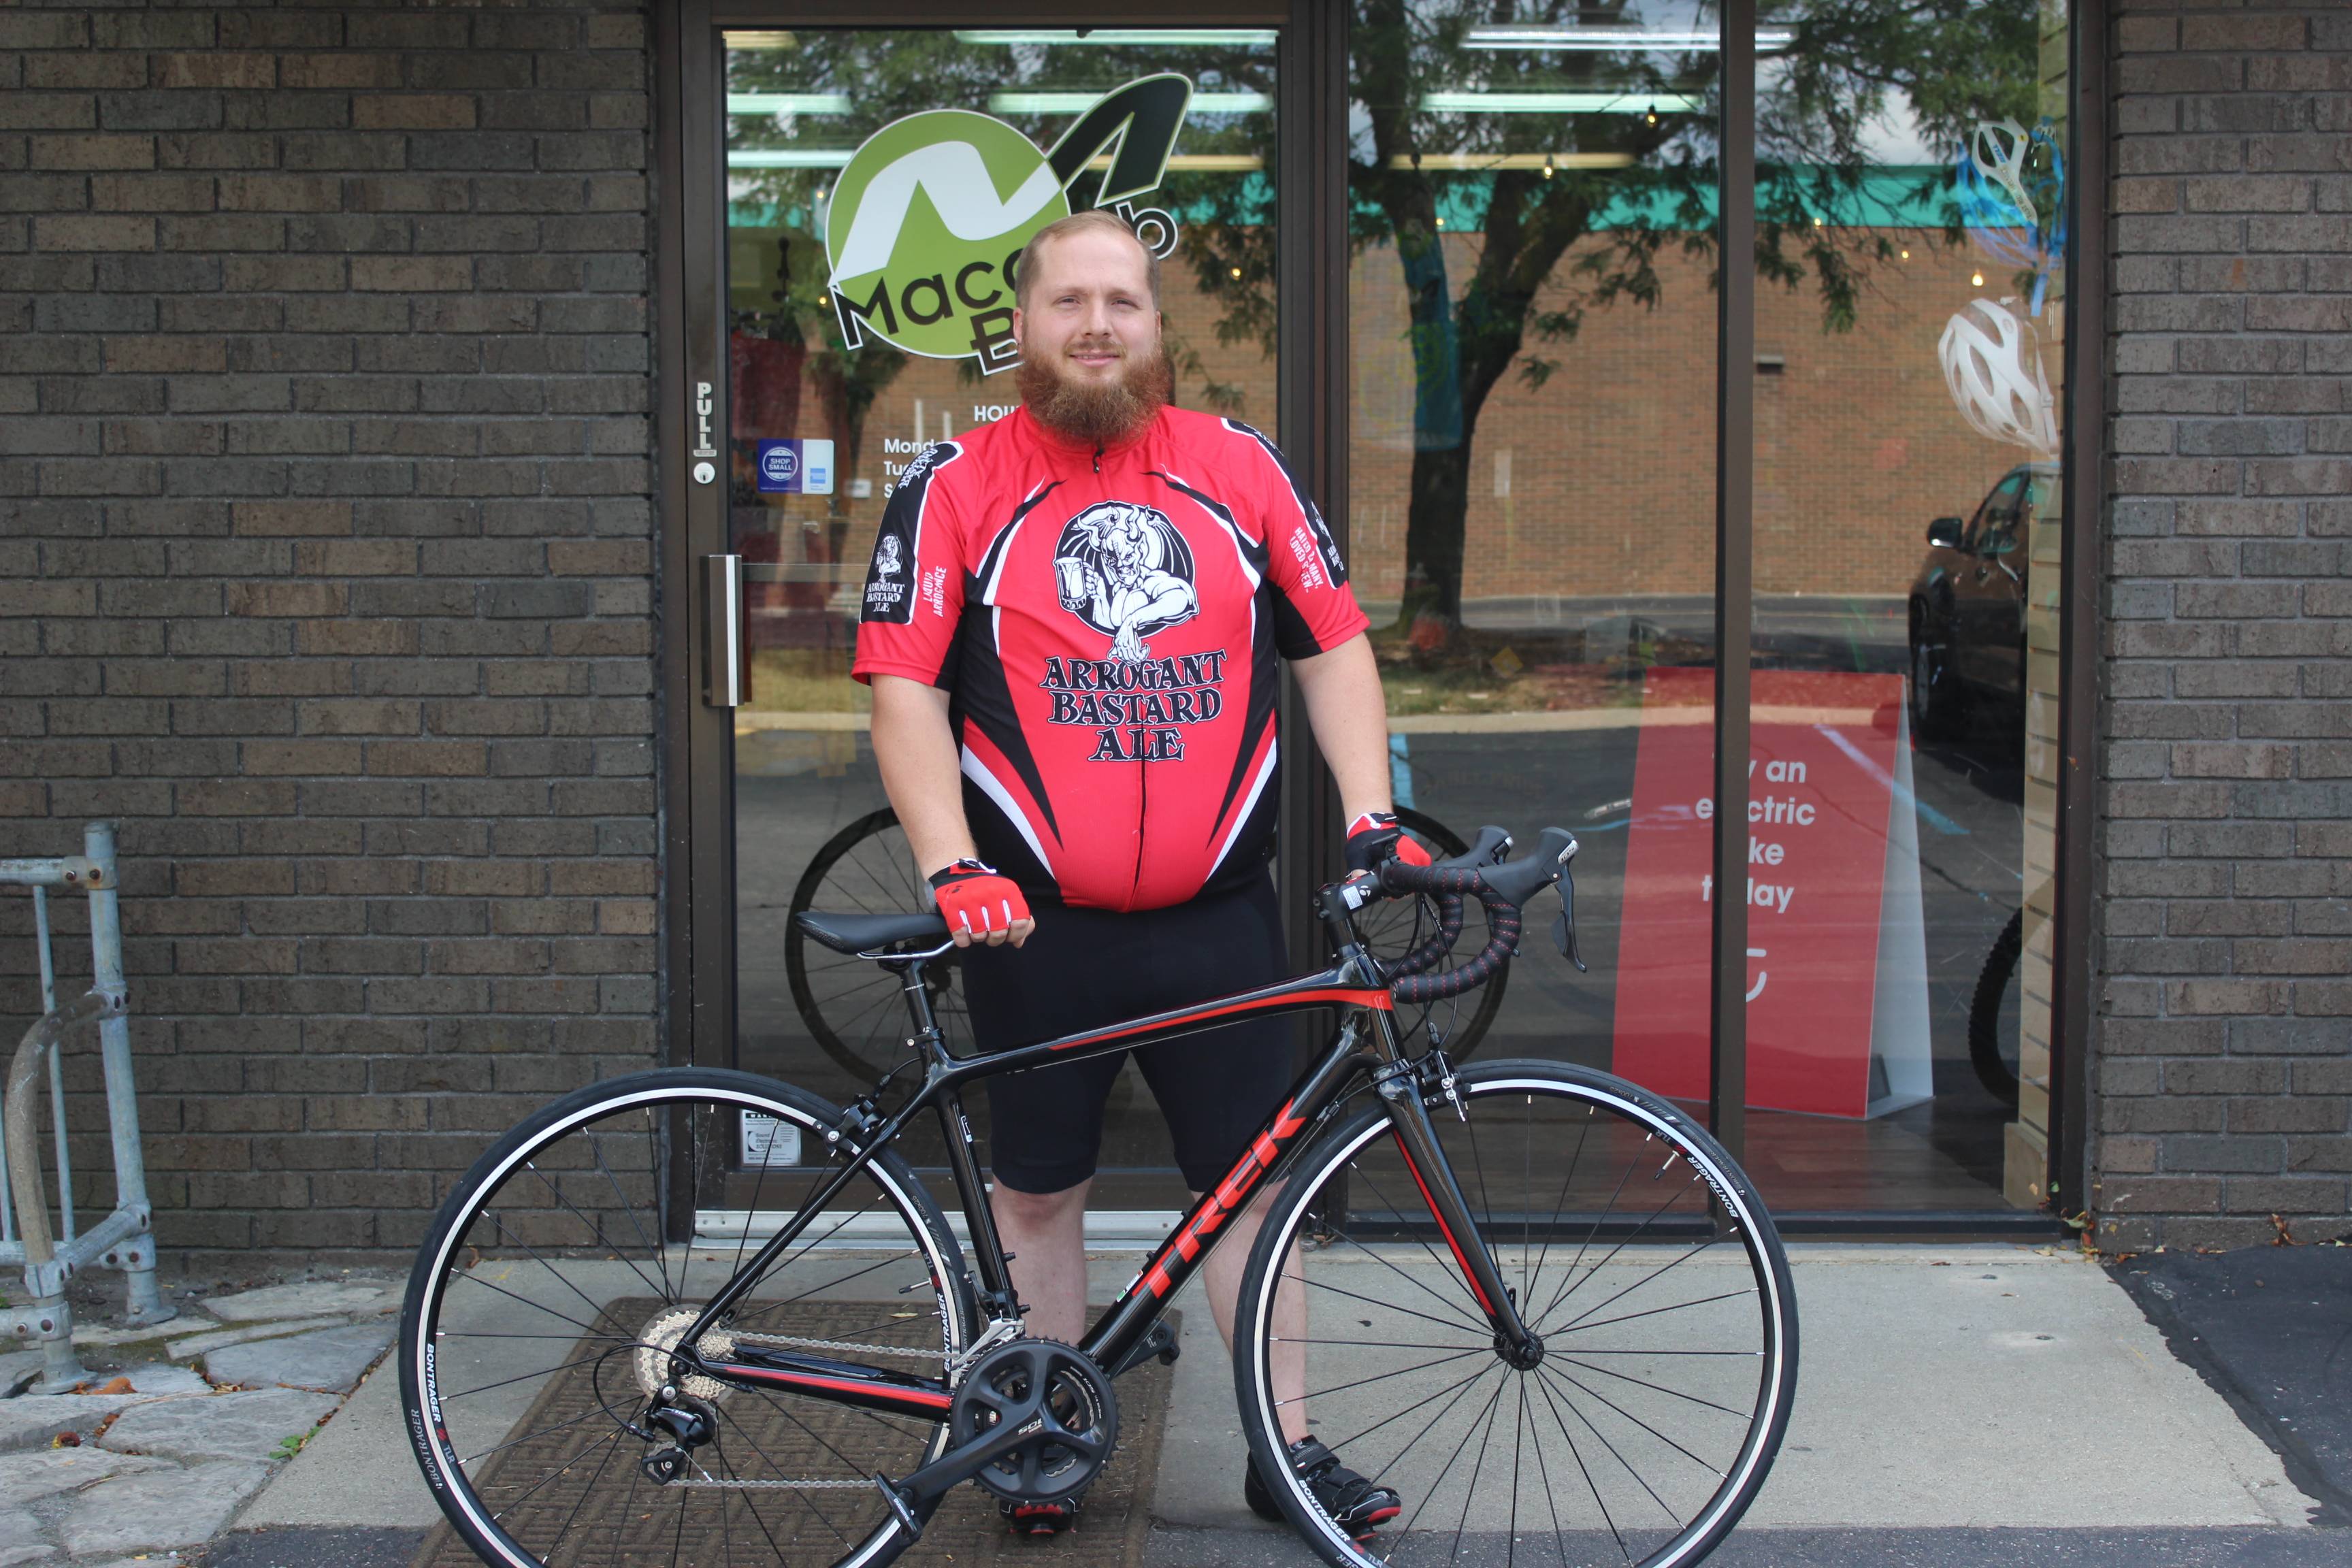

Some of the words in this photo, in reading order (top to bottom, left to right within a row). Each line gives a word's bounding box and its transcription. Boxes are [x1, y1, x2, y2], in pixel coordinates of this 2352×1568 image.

[696, 382, 713, 449] PULL
[884, 438, 936, 454] Mond
[866, 581, 906, 594] ARROGANT
[866, 592, 902, 603] BASTARD
[872, 602, 890, 612] ALE
[1039, 648, 1227, 691] ARROGANT
[1047, 687, 1222, 727] BASTARD
[1087, 727, 1186, 762] ALE
[1765, 760, 1807, 783] an
[1655, 1129, 1671, 1144] TLR
[1132, 1096, 1307, 1299] TREK
[1687, 1156, 1739, 1218] BONTRAGER
[923, 1252, 934, 1271] TLR
[426, 1343, 442, 1423] BONTRAGER
[410, 1408, 440, 1482] BONTRAGER
[442, 1444, 455, 1465] TLR
[1298, 1480, 1351, 1542] BONTRAGER
[1367, 1552, 1384, 1568] TLR
